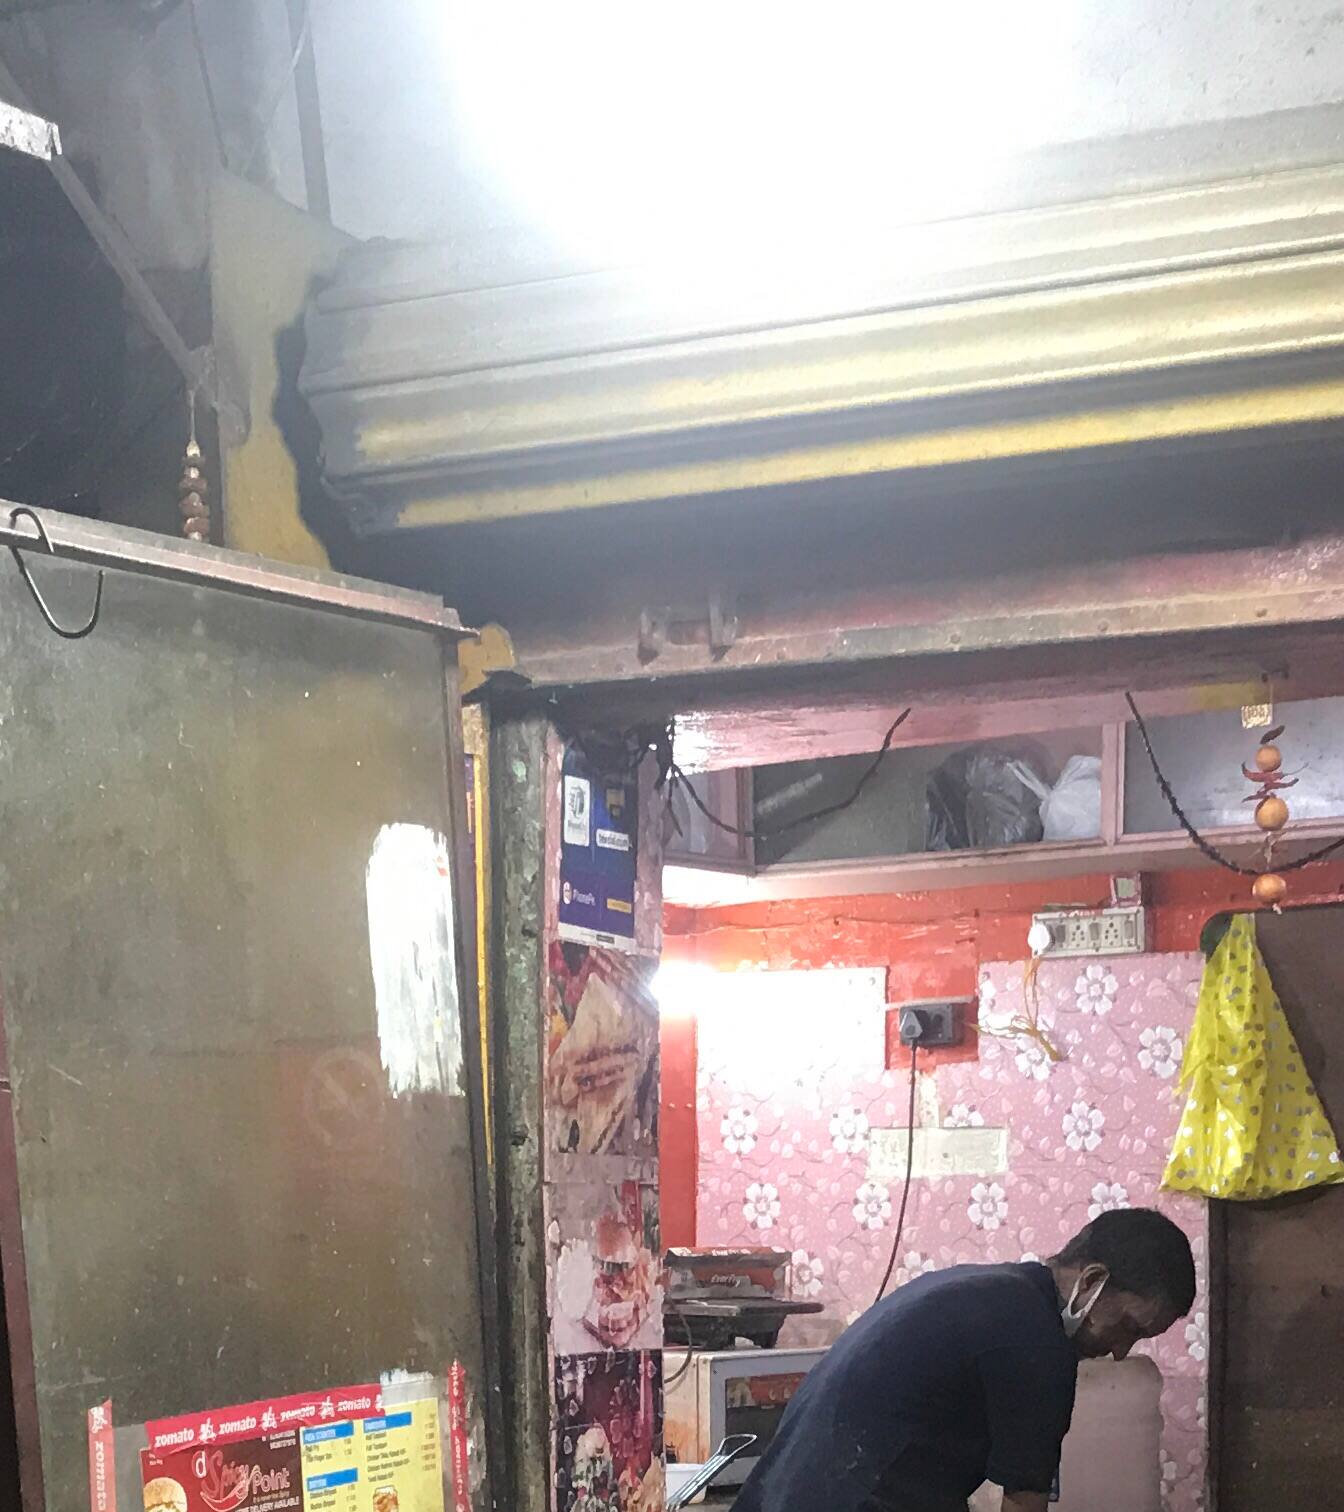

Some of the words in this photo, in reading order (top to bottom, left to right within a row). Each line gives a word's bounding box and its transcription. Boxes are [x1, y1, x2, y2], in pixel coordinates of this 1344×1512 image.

[154, 1428, 194, 1447] zomato
[218, 1417, 256, 1435] zomato
[280, 1404, 315, 1422] zomato
[337, 1395, 371, 1411] zomato
[96, 1441, 106, 1511] zomato
[195, 1451, 207, 1478] d
[252, 1466, 290, 1494] Point
